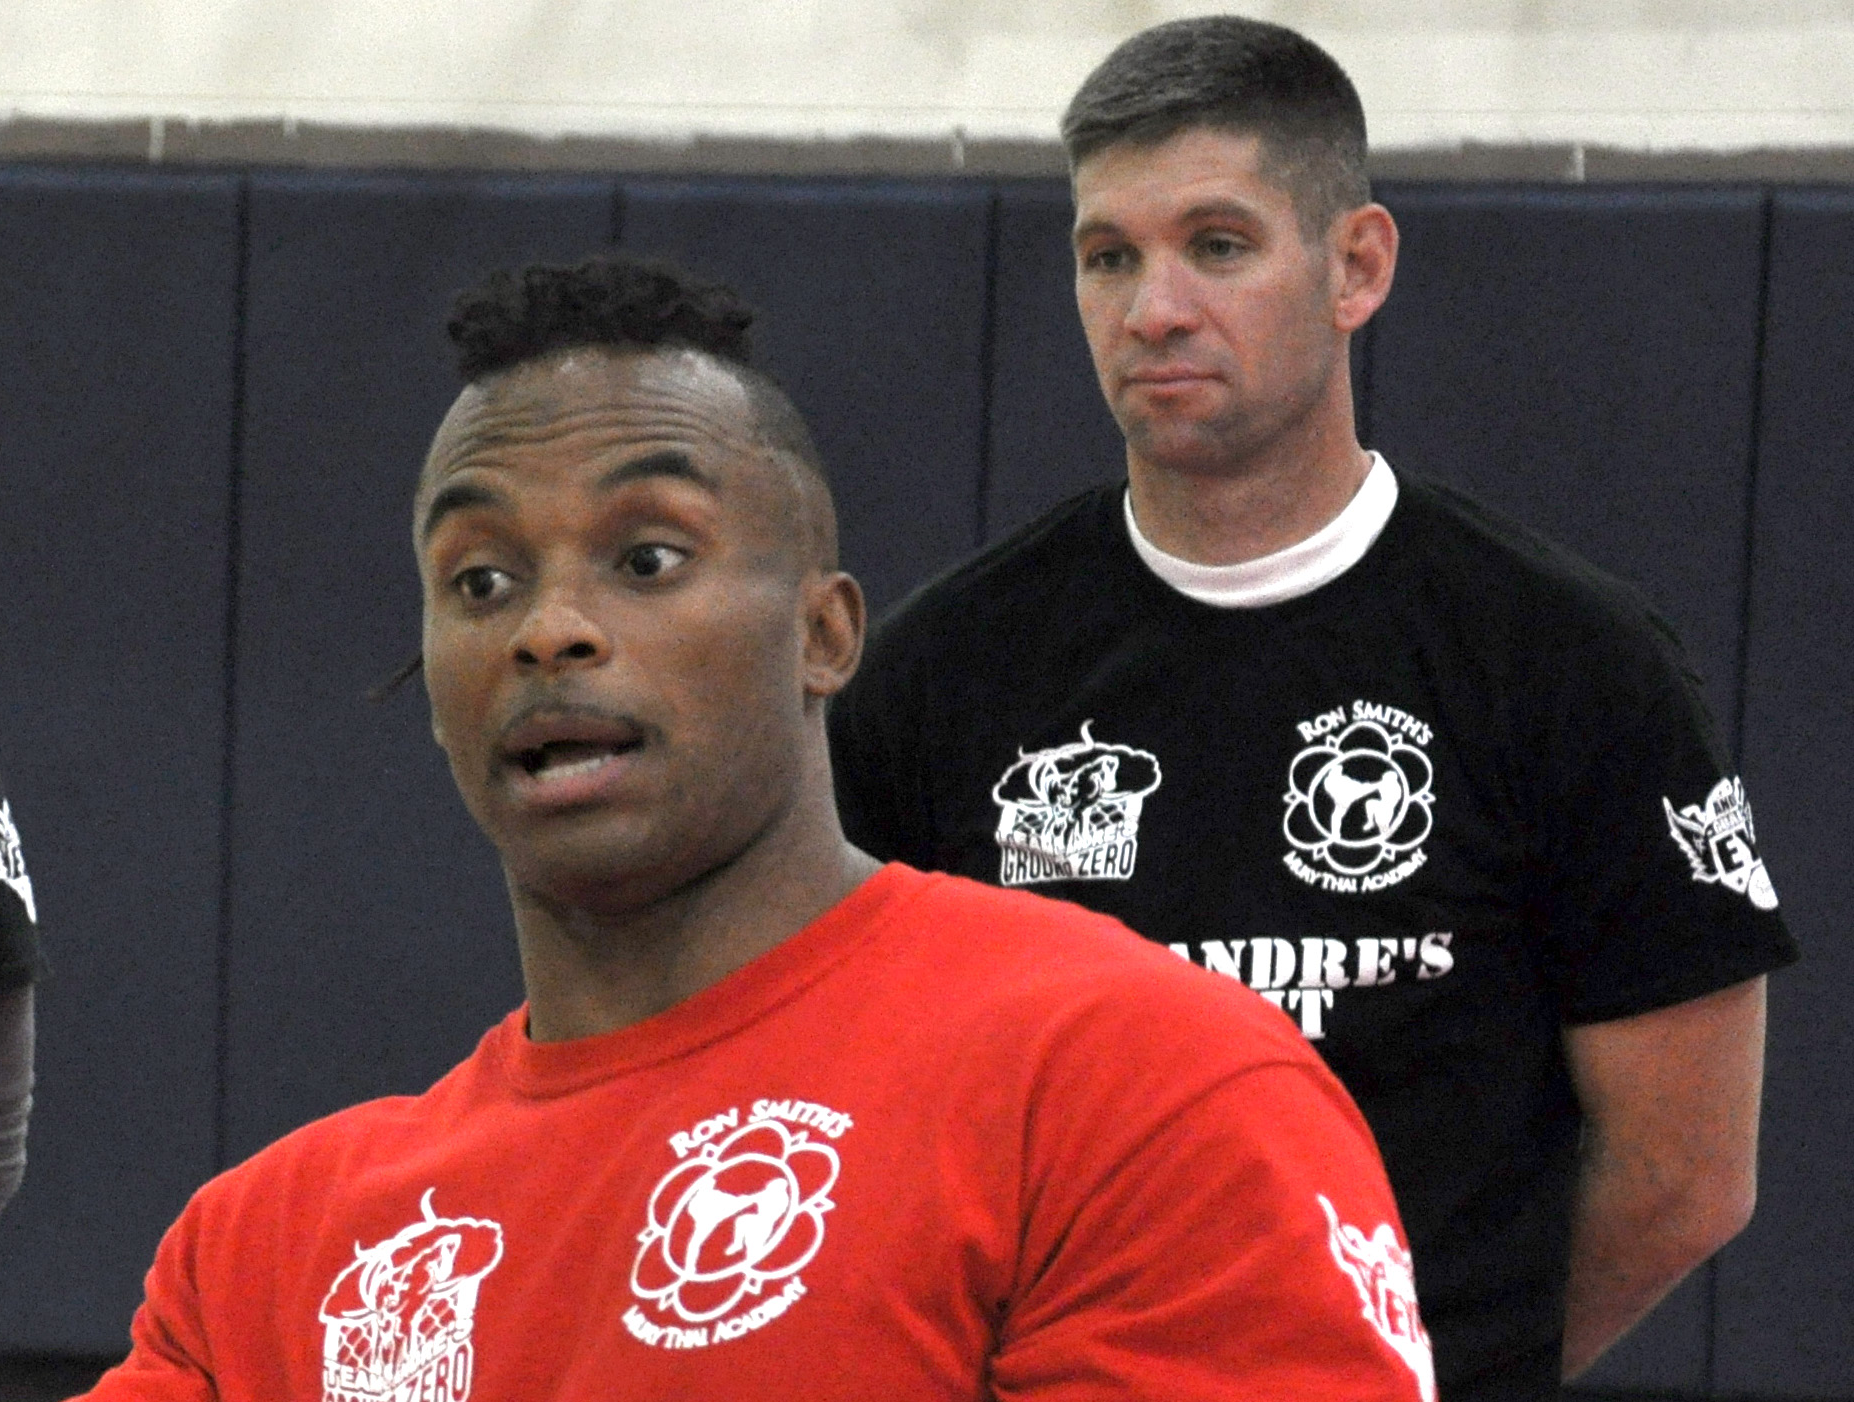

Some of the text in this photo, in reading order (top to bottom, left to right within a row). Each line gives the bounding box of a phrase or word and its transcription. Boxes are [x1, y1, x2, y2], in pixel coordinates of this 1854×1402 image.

[1297, 699, 1433, 746] RON SMITH'S
[1003, 839, 1135, 884] GROUND ZERO
[668, 1107, 738, 1158] RON
